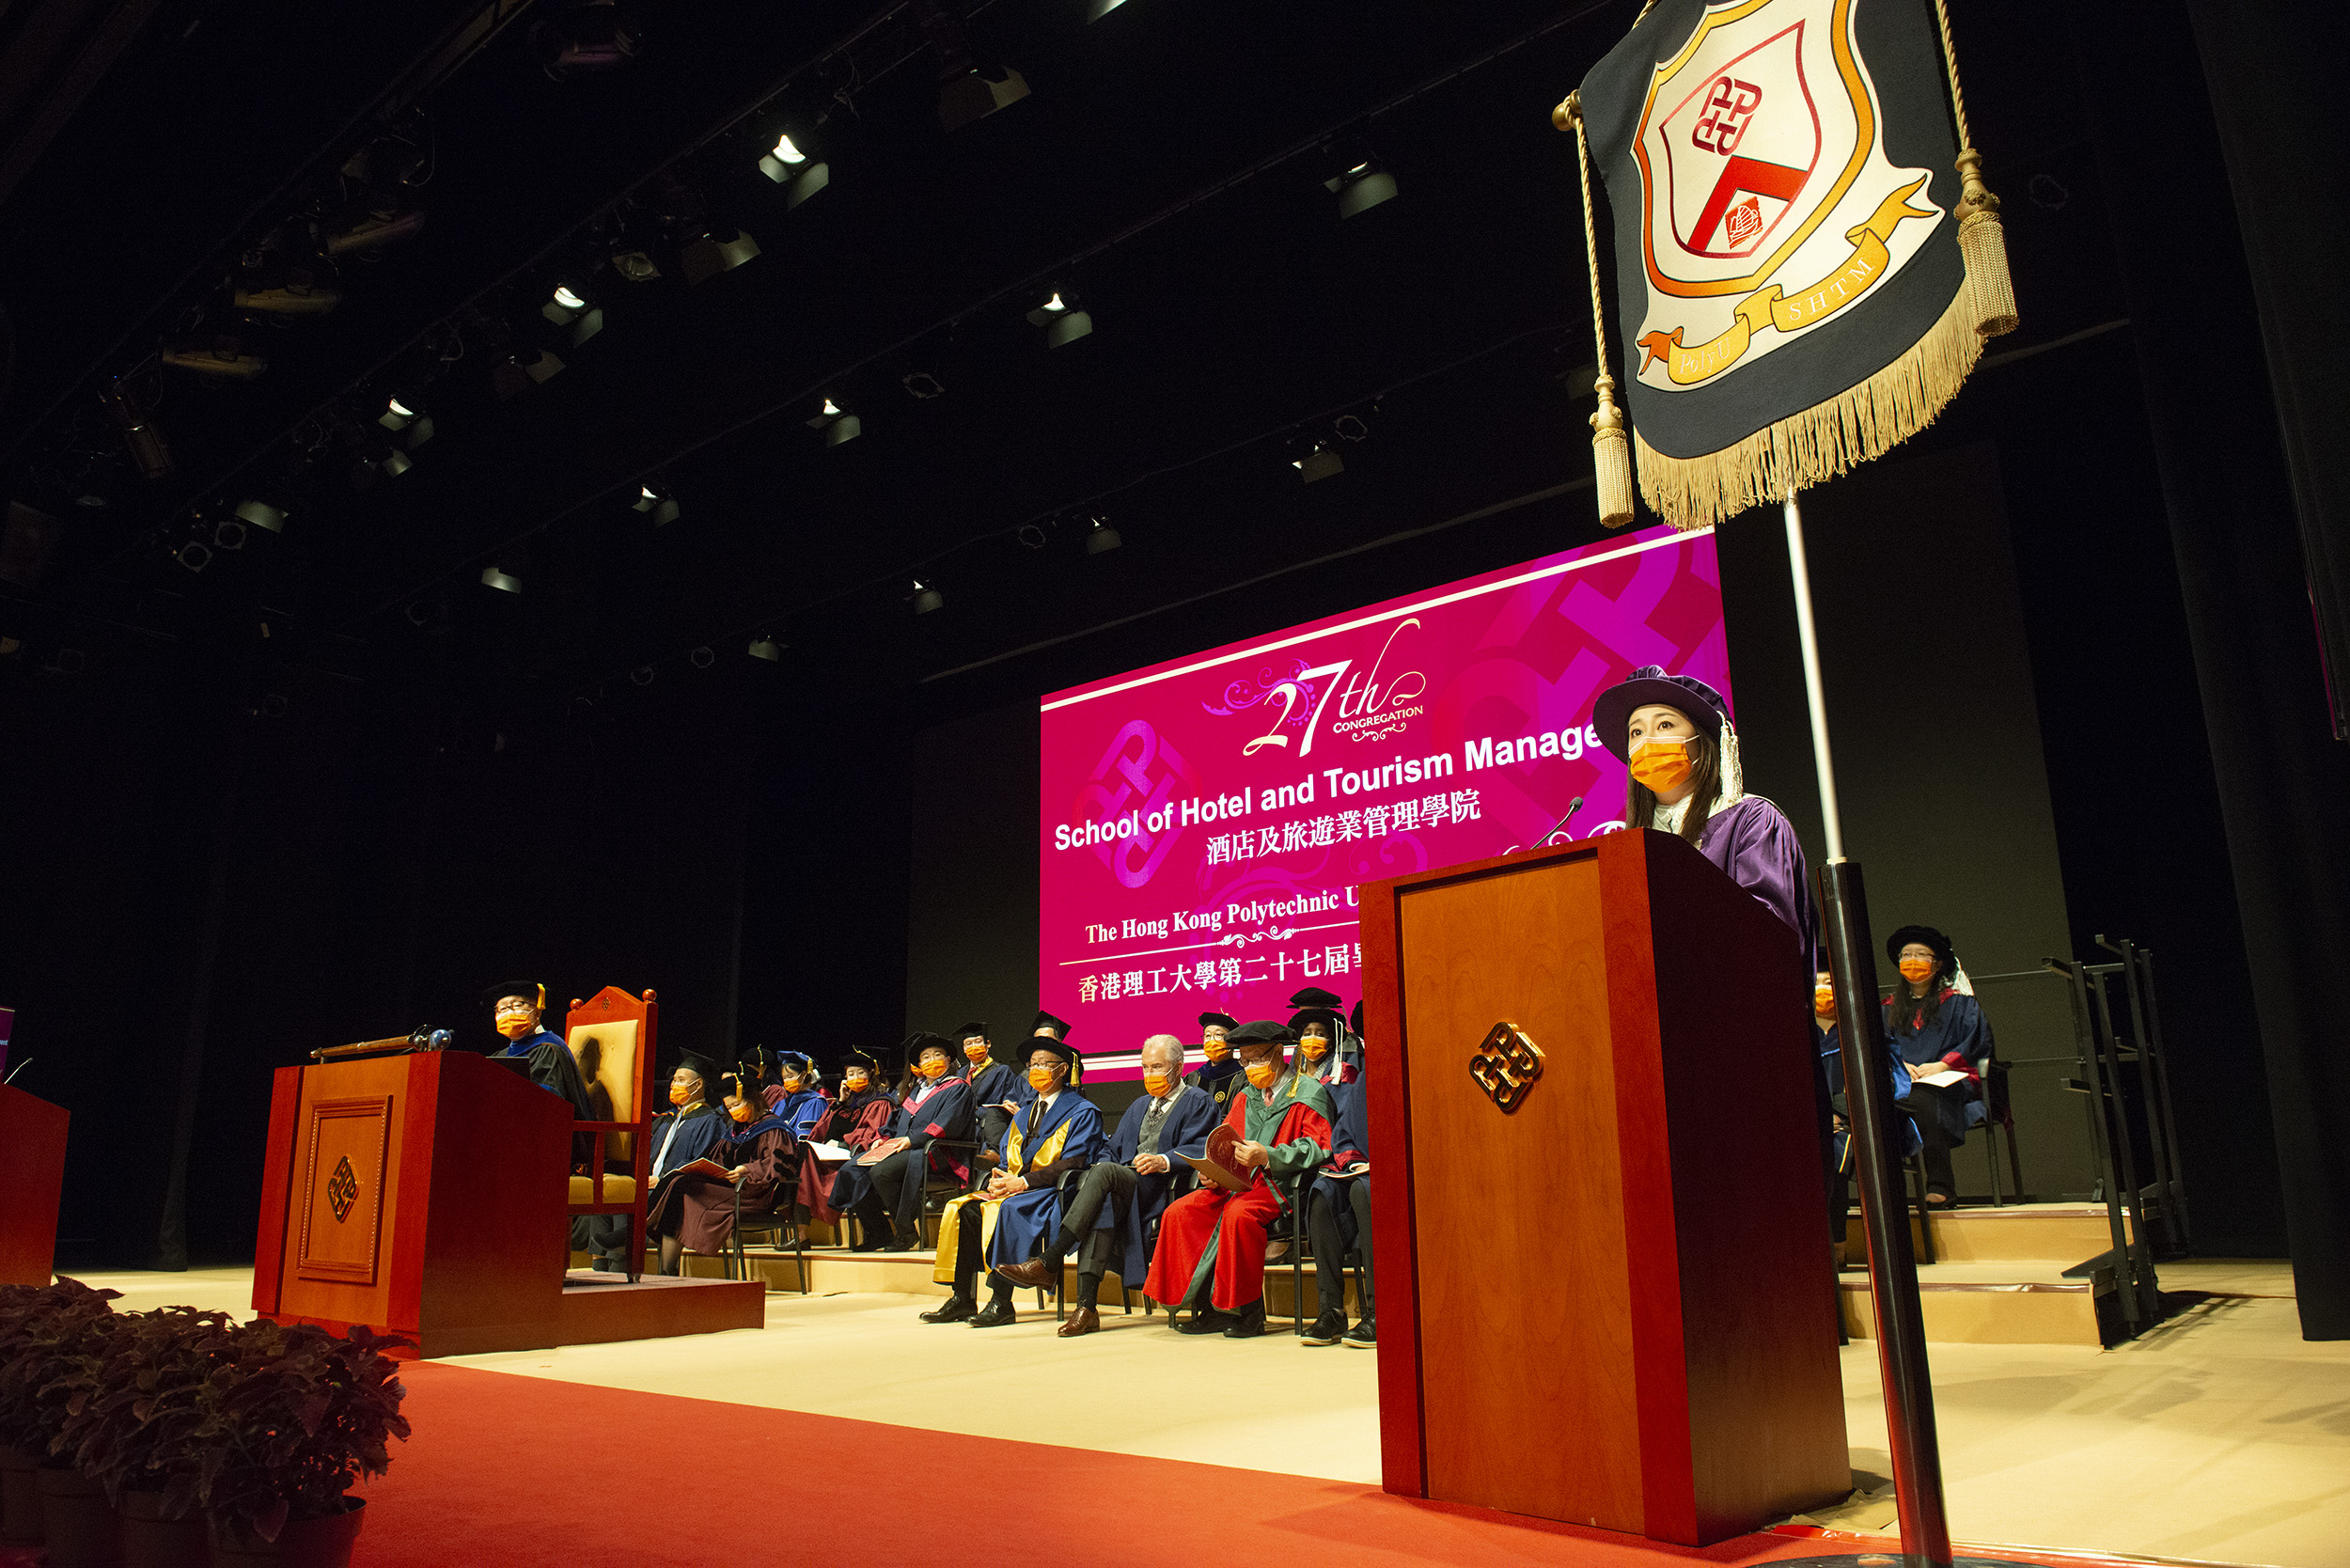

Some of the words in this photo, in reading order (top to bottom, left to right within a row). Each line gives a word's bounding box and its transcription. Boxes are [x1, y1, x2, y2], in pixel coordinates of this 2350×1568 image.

[1789, 257, 1875, 321] SHTM
[1679, 337, 1731, 374] PolyU
[1243, 618, 1426, 758] 27th
[1333, 705, 1423, 733] CONGREGATION
[1055, 809, 1138, 851] School
[1147, 802, 1174, 832] of
[1181, 787, 1251, 826] Hotel
[1261, 774, 1314, 811] and
[1324, 753, 1453, 798] Tourism
[1465, 723, 1604, 772] Manage
[1206, 789, 1481, 865] 酒店及旅遊業管理學院
[1085, 923, 1118, 944] The
[1121, 918, 1168, 939] Hong
[1173, 911, 1222, 932] Kong
[1227, 890, 1340, 925] Polytechnic
